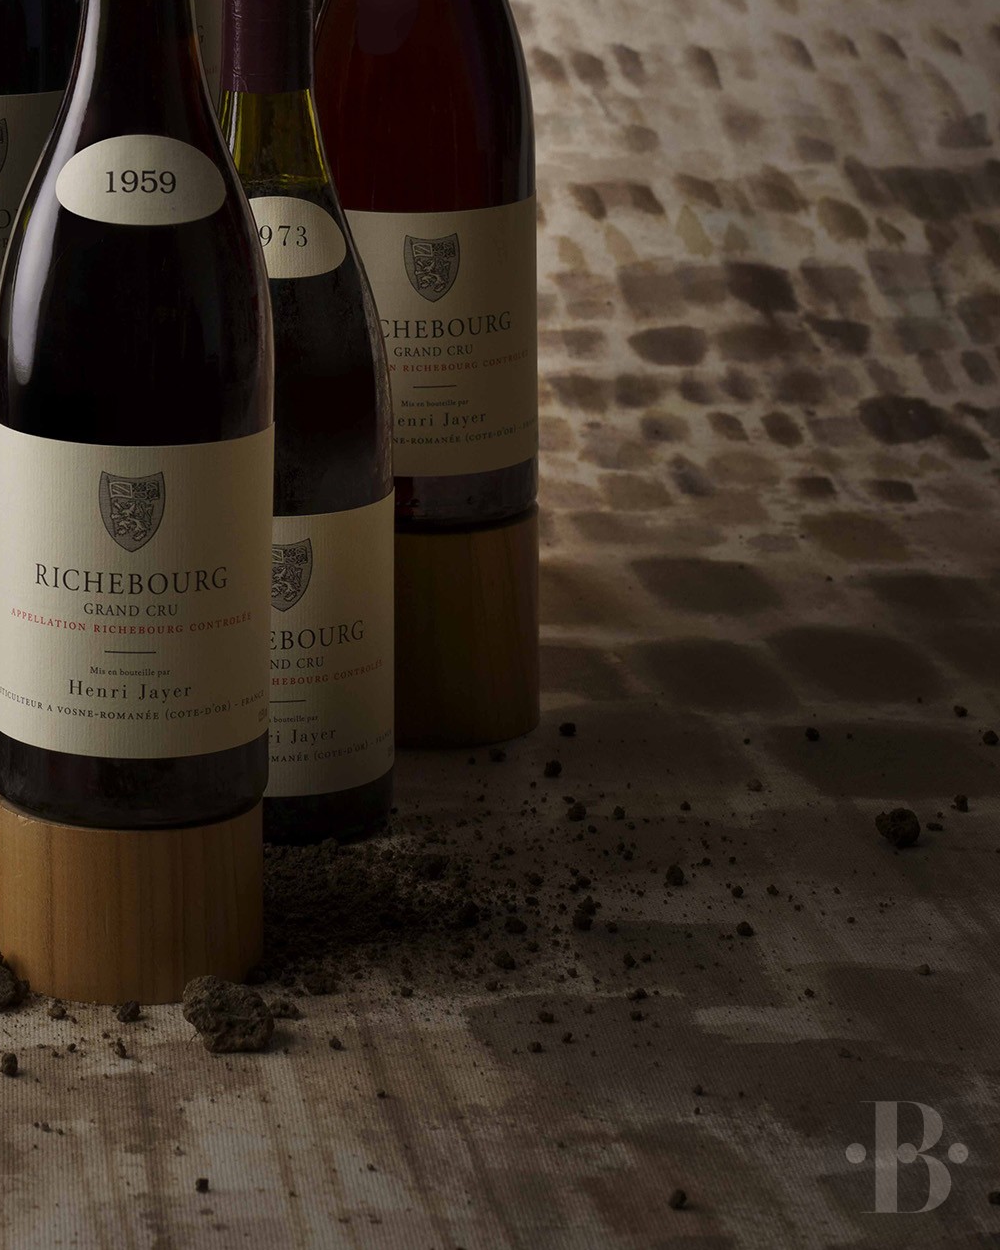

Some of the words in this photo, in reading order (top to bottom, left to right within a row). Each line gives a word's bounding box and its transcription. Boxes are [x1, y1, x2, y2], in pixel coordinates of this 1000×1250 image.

[105, 170, 177, 194] 1959
[259, 224, 308, 248] 973
[380, 311, 512, 339] CHEBOURG
[393, 346, 442, 358] GRAND
[447, 344, 473, 356] CRU
[402, 361, 478, 372] RICHEBOURG
[426, 399, 457, 407] bouteille
[457, 400, 470, 408] par
[397, 413, 434, 427] enri
[443, 412, 487, 429] Jayer
[392, 434, 462, 445] NE-ROMANÉE
[35, 563, 228, 595] RICHEBOURG
[83, 602, 140, 617] GRAND
[145, 603, 179, 617] CRU
[10, 607, 87, 632] APPELLATION
[93, 624, 184, 635] RICHEBOURG
[189, 611, 253, 632] CONTROLÉE
[269, 620, 364, 651] EBOURG
[296, 656, 324, 668] CRU
[89, 666, 106, 676] Mis
[107, 668, 117, 676] en
[119, 666, 154, 677] bouteille
[157, 668, 171, 678] par
[272, 674, 329, 686] HEBOURG
[68, 679, 127, 699] Henri
[138, 683, 192, 704] Jayer
[46, 704, 53, 712] A
[57, 705, 160, 721] VOSNE-ROMANÉE
[307, 715, 319, 724] par
[290, 729, 336, 746] Jayer
